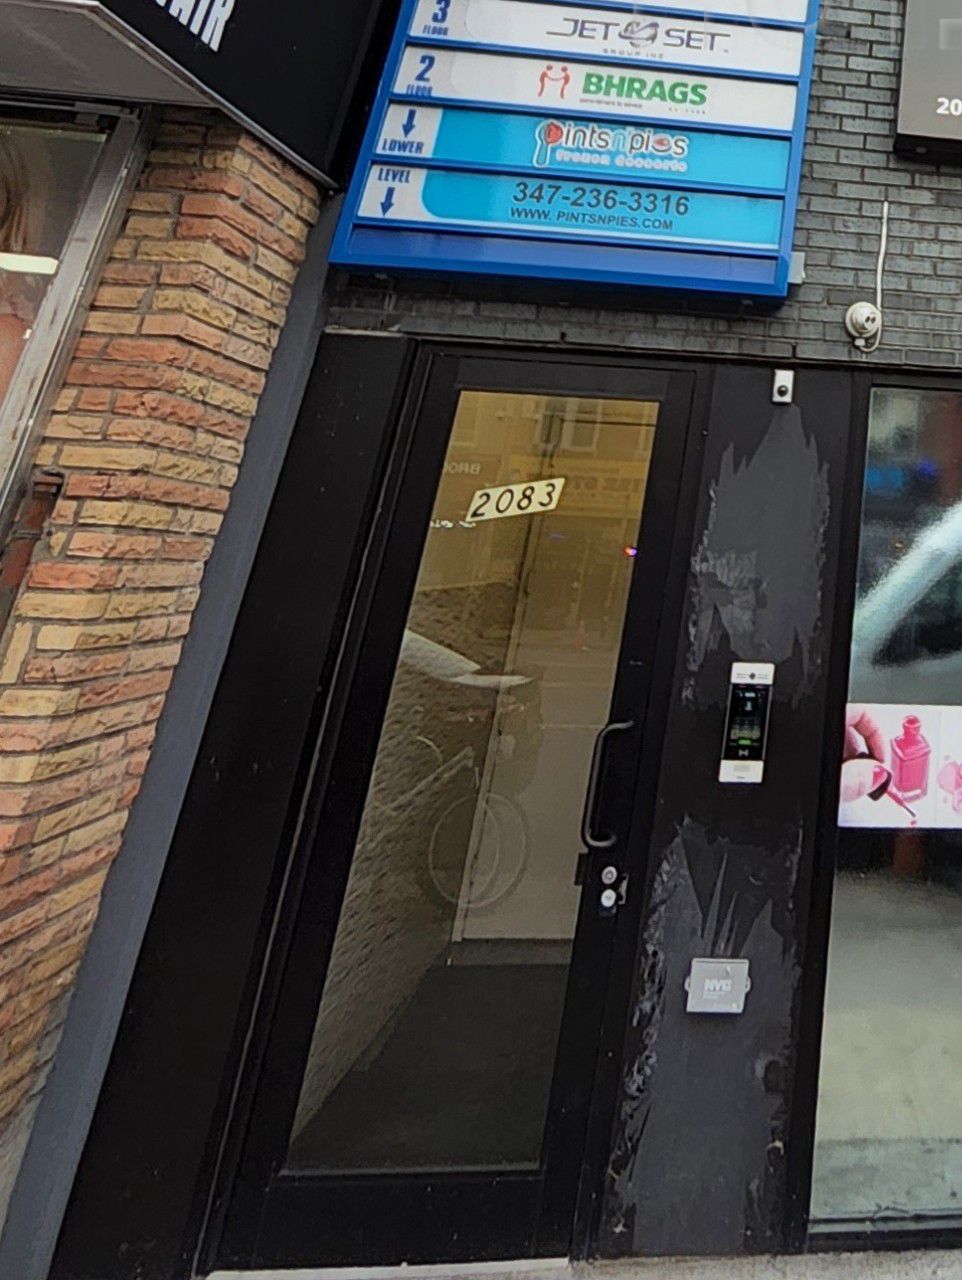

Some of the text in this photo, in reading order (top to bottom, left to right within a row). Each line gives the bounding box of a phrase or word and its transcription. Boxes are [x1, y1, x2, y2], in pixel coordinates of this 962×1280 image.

[546, 17, 732, 51] JET SET
[415, 55, 436, 82] 2
[581, 72, 708, 106] BHRAGS
[381, 138, 424, 154] LOWER
[378, 167, 411, 184] LEVEL
[512, 181, 691, 216] 347-236-3316
[470, 482, 557, 518] 2083
